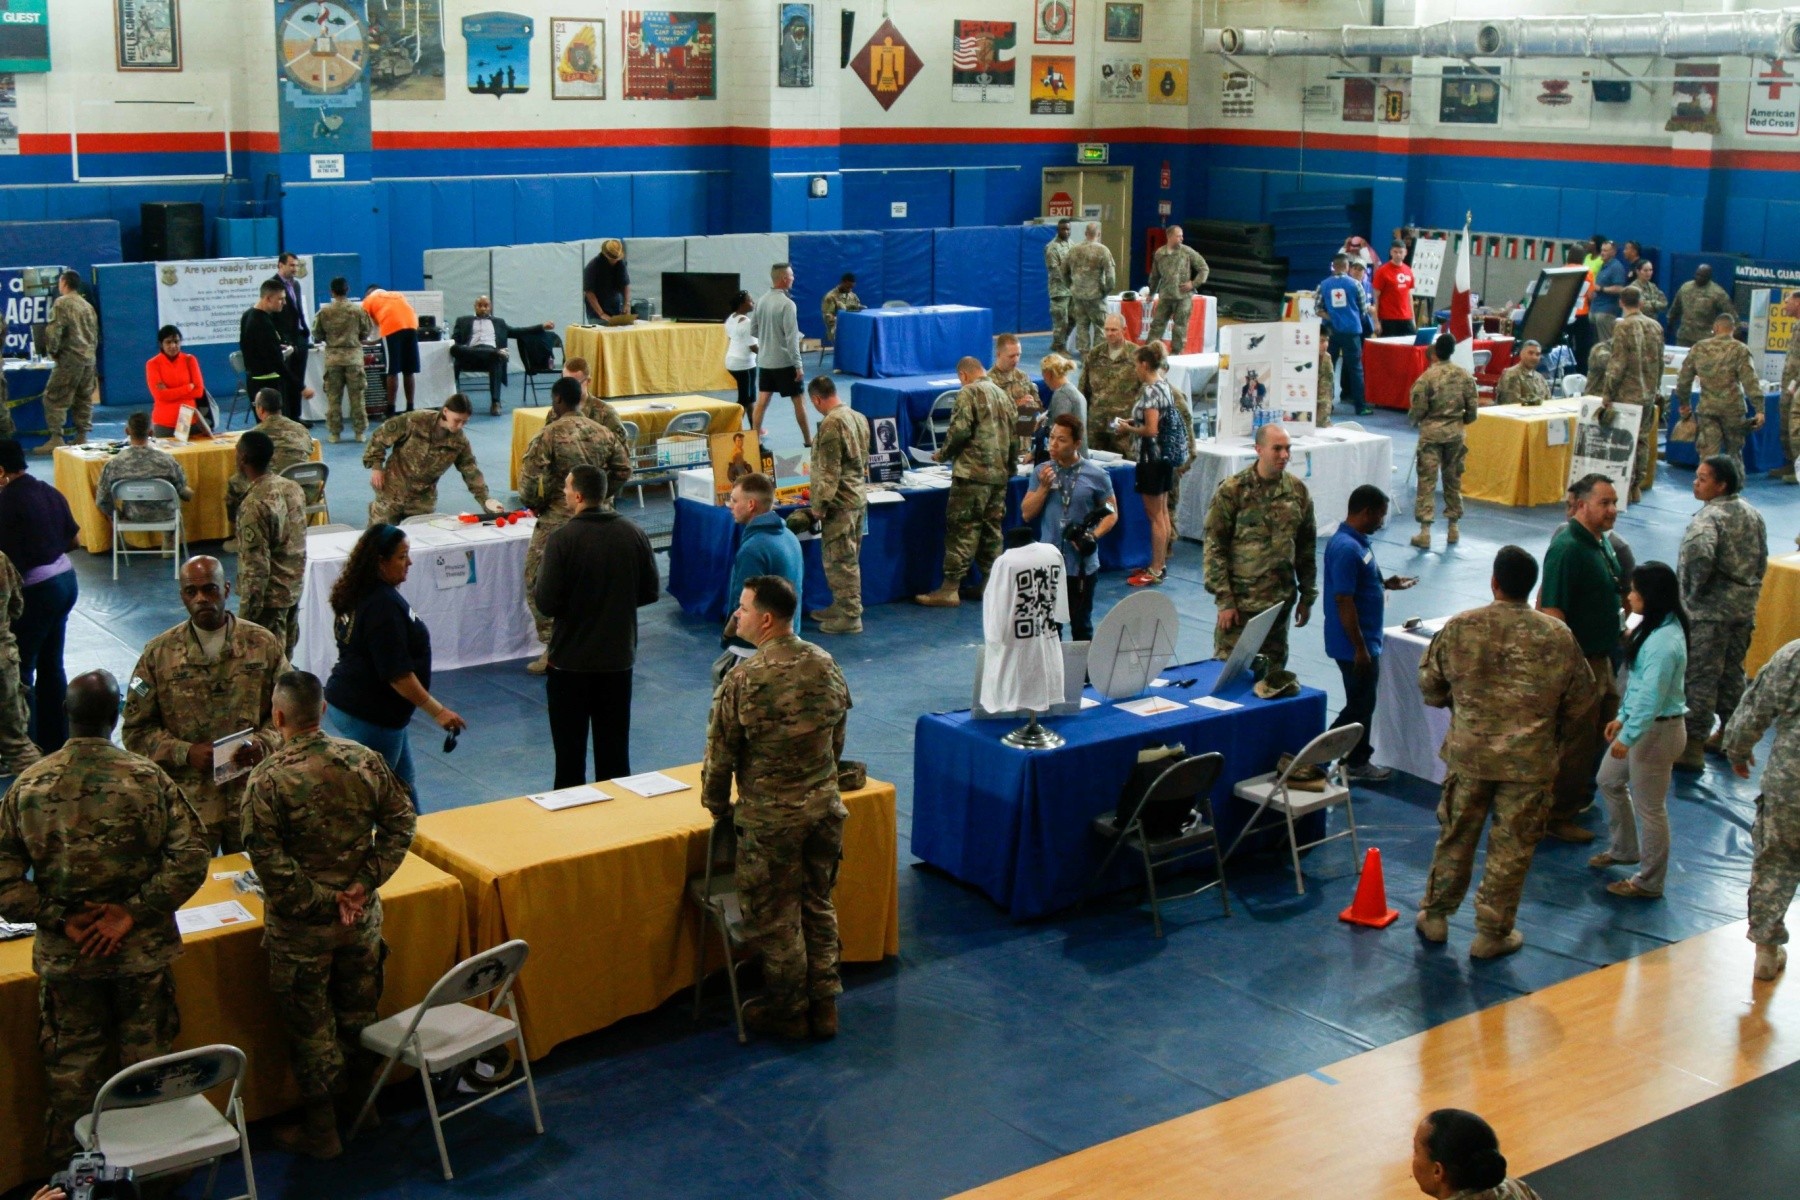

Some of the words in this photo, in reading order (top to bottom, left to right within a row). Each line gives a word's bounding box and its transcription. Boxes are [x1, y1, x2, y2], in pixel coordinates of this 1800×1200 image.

[3, 11, 41, 23] GUEST
[125, 0, 135, 30] COMIN
[1751, 108, 1795, 117] American
[1749, 118, 1766, 126] Red
[1768, 118, 1795, 127] Cross
[1049, 207, 1073, 216] EXIT
[184, 266, 199, 274] Are
[201, 267, 218, 275] you
[219, 262, 243, 273] ready
[245, 263, 257, 271] for
[1735, 266, 1776, 278] NATIONAL
[1777, 270, 1800, 279] GUAR
[219, 275, 253, 285] change?
[5, 296, 53, 324] AGE
[762, 457, 773, 467] 10
